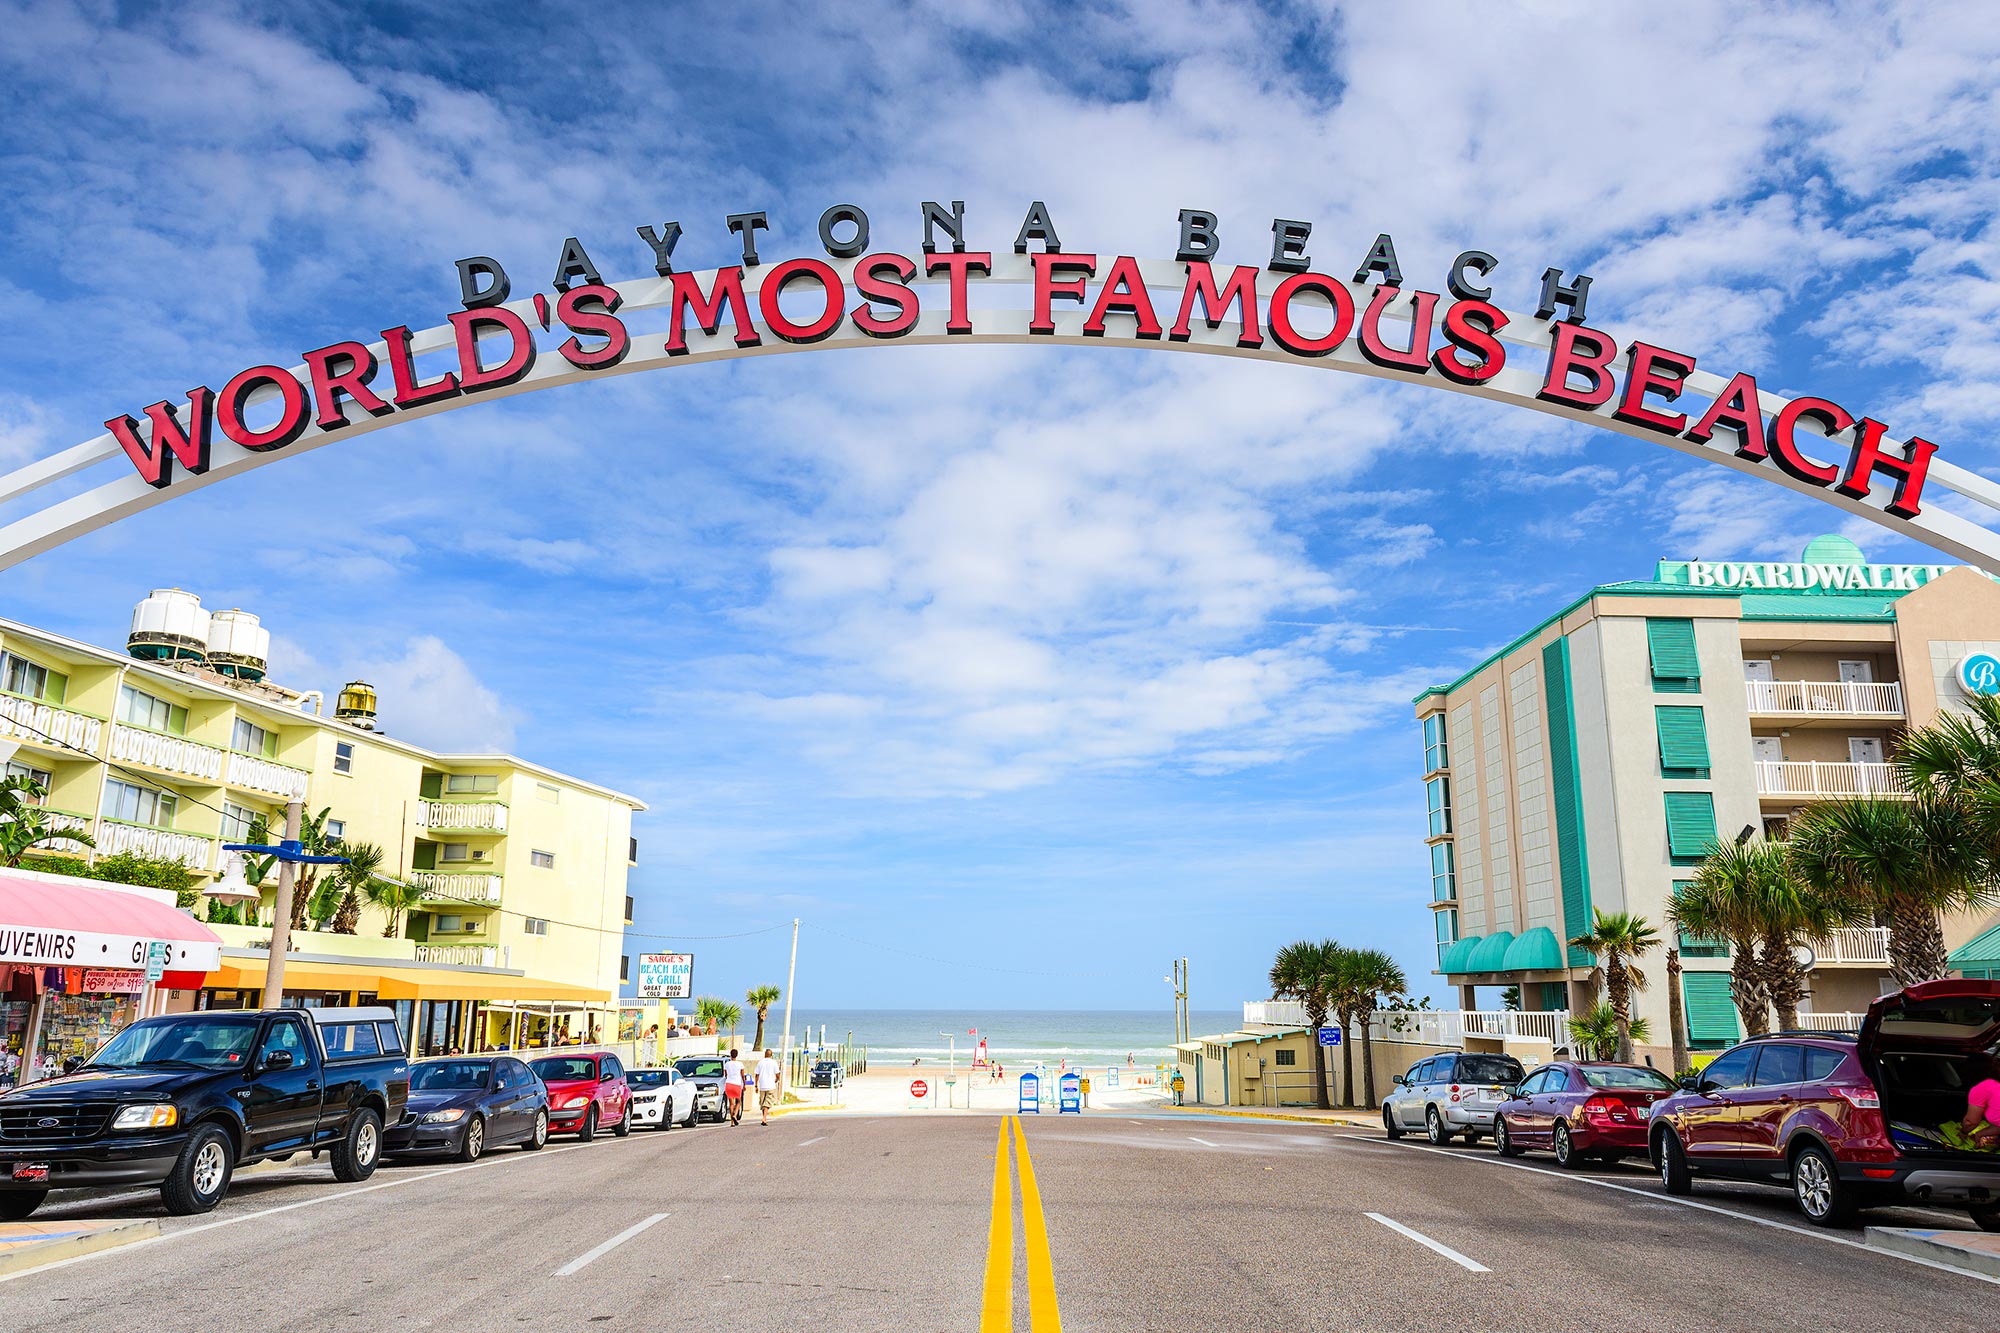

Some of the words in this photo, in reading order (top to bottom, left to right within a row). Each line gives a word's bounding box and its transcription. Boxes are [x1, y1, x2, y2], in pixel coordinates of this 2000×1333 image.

[455, 201, 1061, 309] DAYTONA
[1175, 208, 1593, 326] BEACH
[104, 284, 631, 489] WORLD'S
[664, 251, 991, 356] MOST
[1030, 252, 1510, 385] FAMOUS
[1535, 320, 1939, 520] BEACH
[1687, 562, 1921, 591] BOARDWALK
[1970, 660, 1997, 691] B
[132, 941, 172, 966] GIS
[648, 955, 684, 963] SARGE'S
[641, 964, 669, 974] BEACH
[672, 964, 690, 974] BAR
[646, 975, 654, 985] &
[657, 975, 682, 985] GRILL
